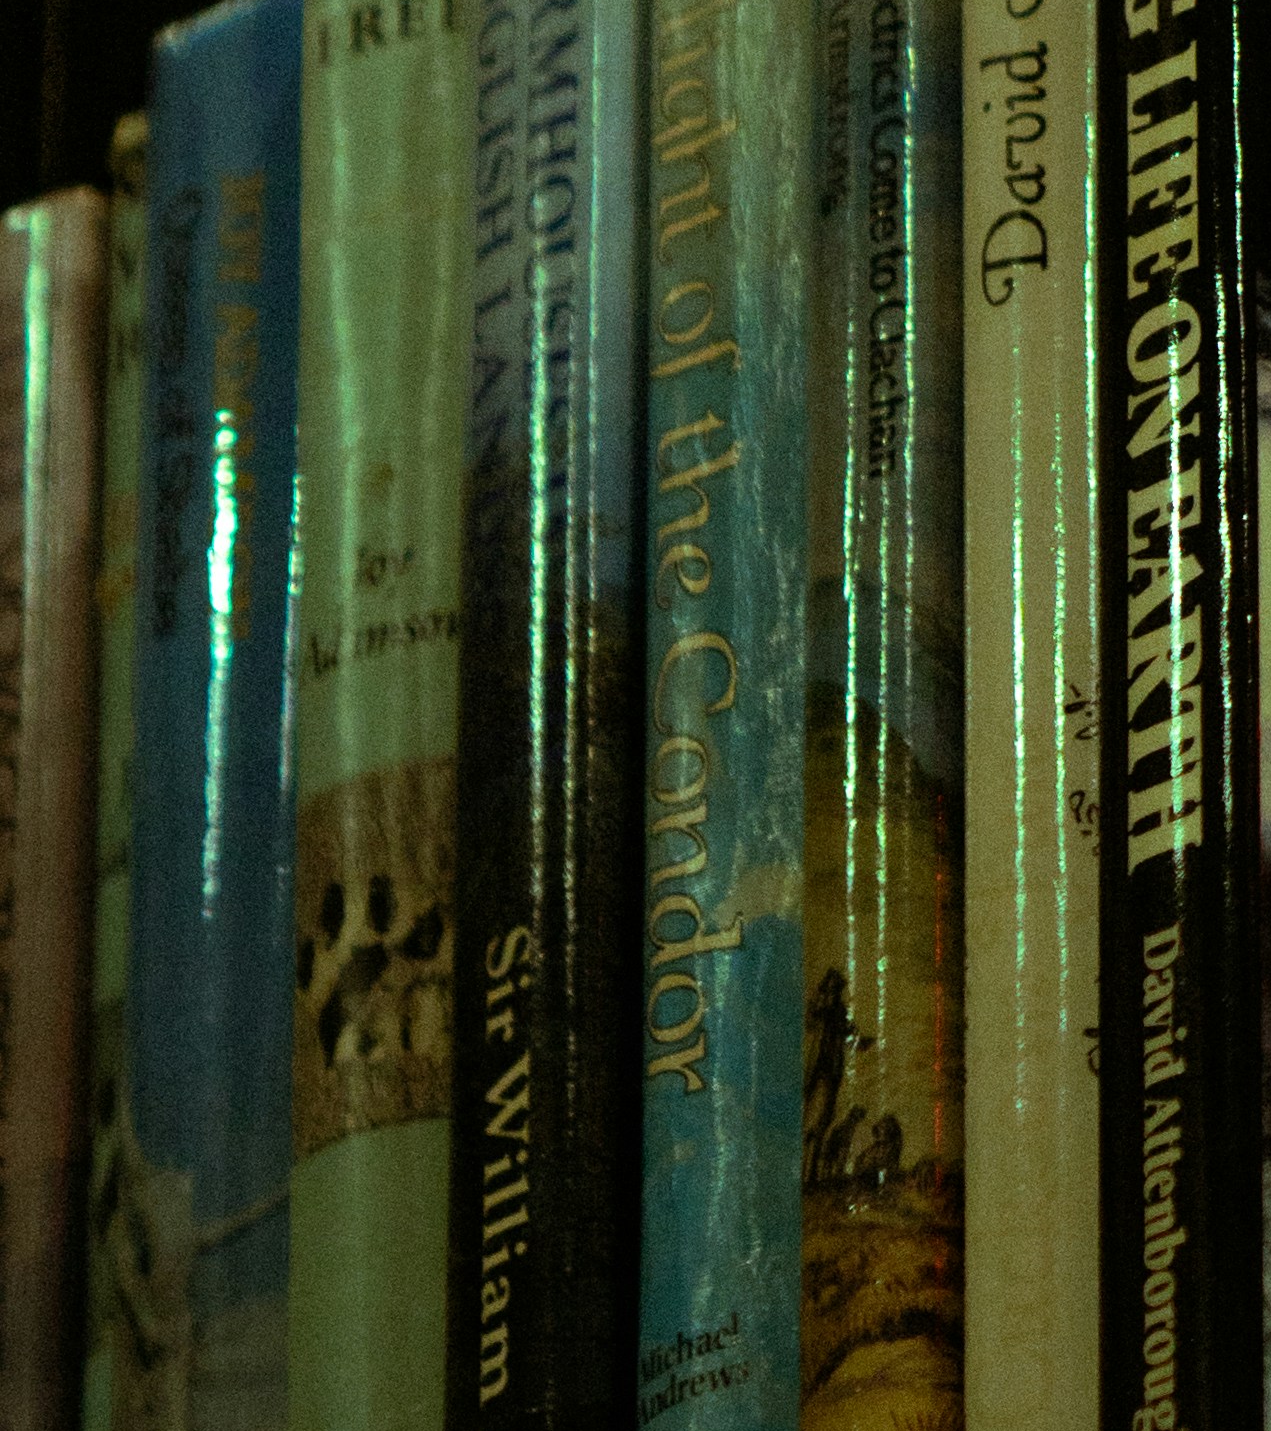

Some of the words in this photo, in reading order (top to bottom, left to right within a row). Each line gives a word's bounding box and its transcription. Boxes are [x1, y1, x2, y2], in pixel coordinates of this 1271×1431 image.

[870, 116, 914, 248] Come
[1124, 40, 1202, 300] LIFE
[648, 278, 744, 384] of
[868, 248, 906, 292] to
[866, 298, 910, 480] Clachan
[1124, 300, 1204, 458] ON
[652, 408, 742, 610] the
[1124, 458, 1204, 876] EARTH
[648, 630, 748, 1098] Condor
[484, 926, 534, 1040] Sir
[1142, 922, 1186, 1088] David
[480, 1052, 530, 1402] William
